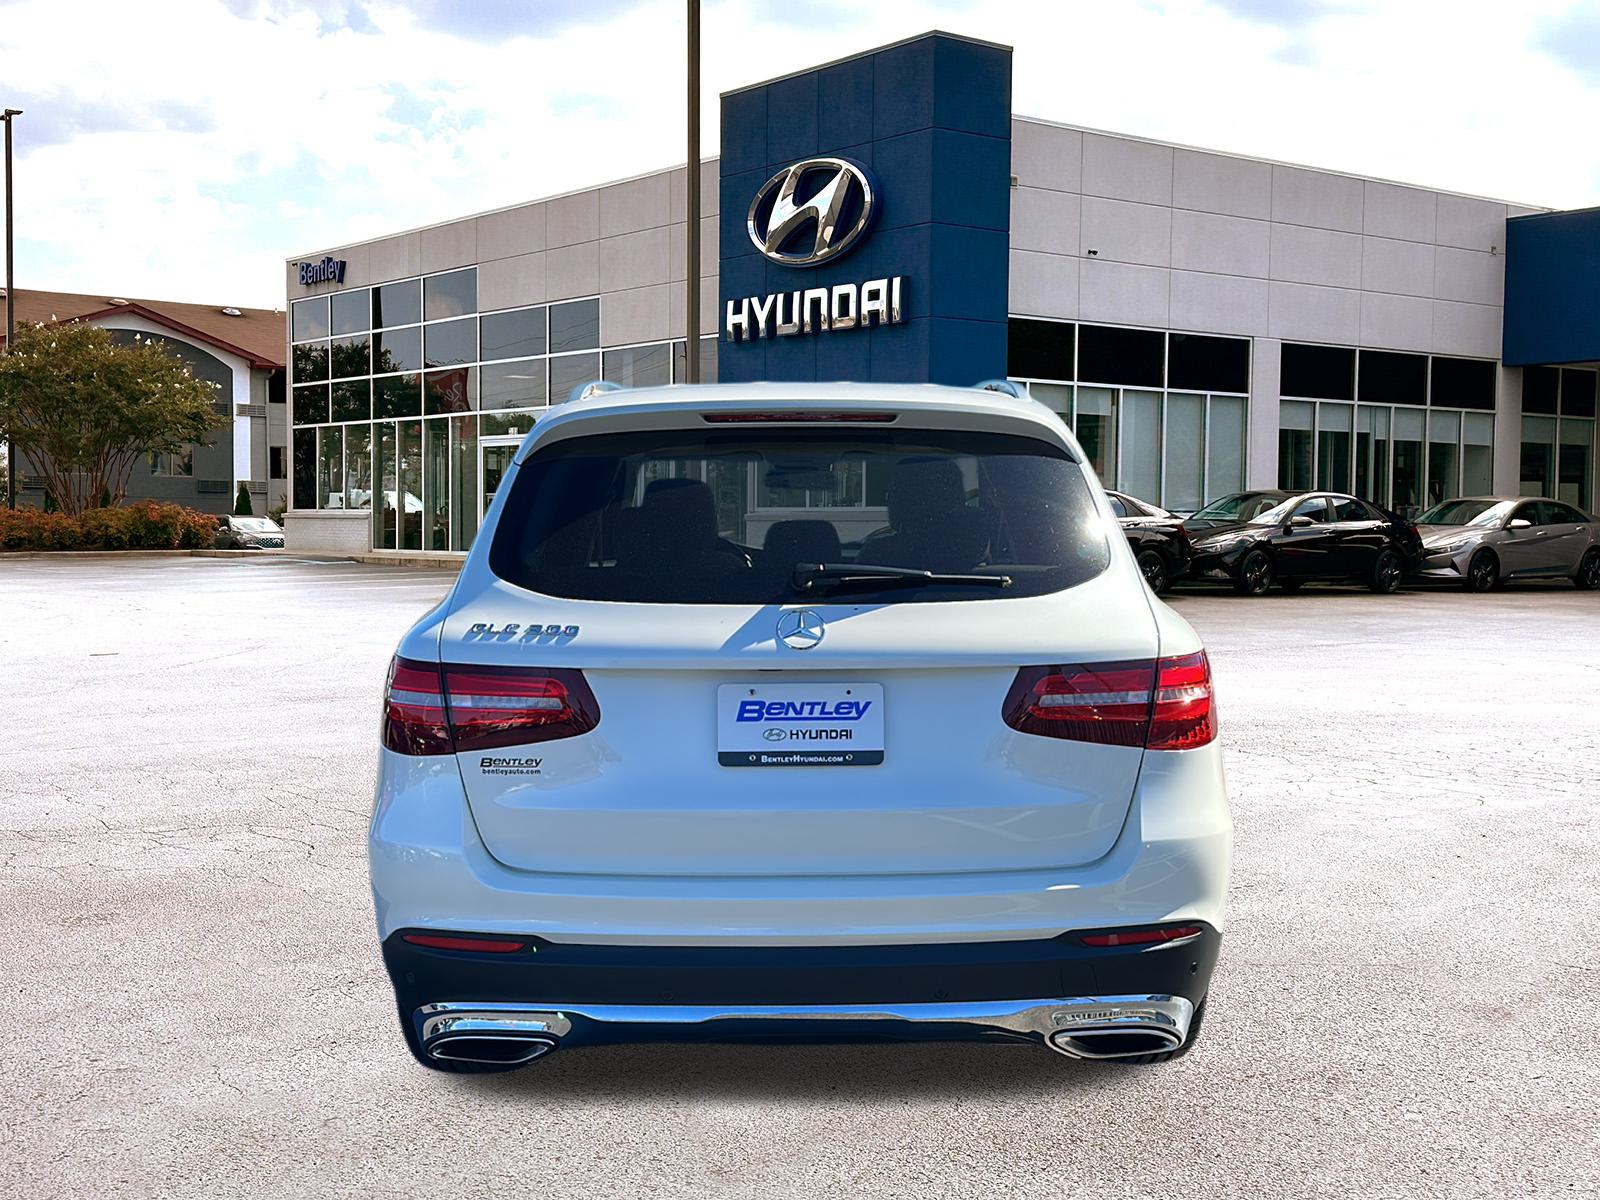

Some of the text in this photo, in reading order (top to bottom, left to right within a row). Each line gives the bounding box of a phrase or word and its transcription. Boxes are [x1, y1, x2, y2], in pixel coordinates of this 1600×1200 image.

[299, 257, 345, 284] Bentley
[726, 276, 904, 342] HYUNDAI
[470, 623, 580, 636] GLC 300
[789, 729, 853, 740] HYUNDAI
[482, 768, 541, 776] bentleyauto.com
